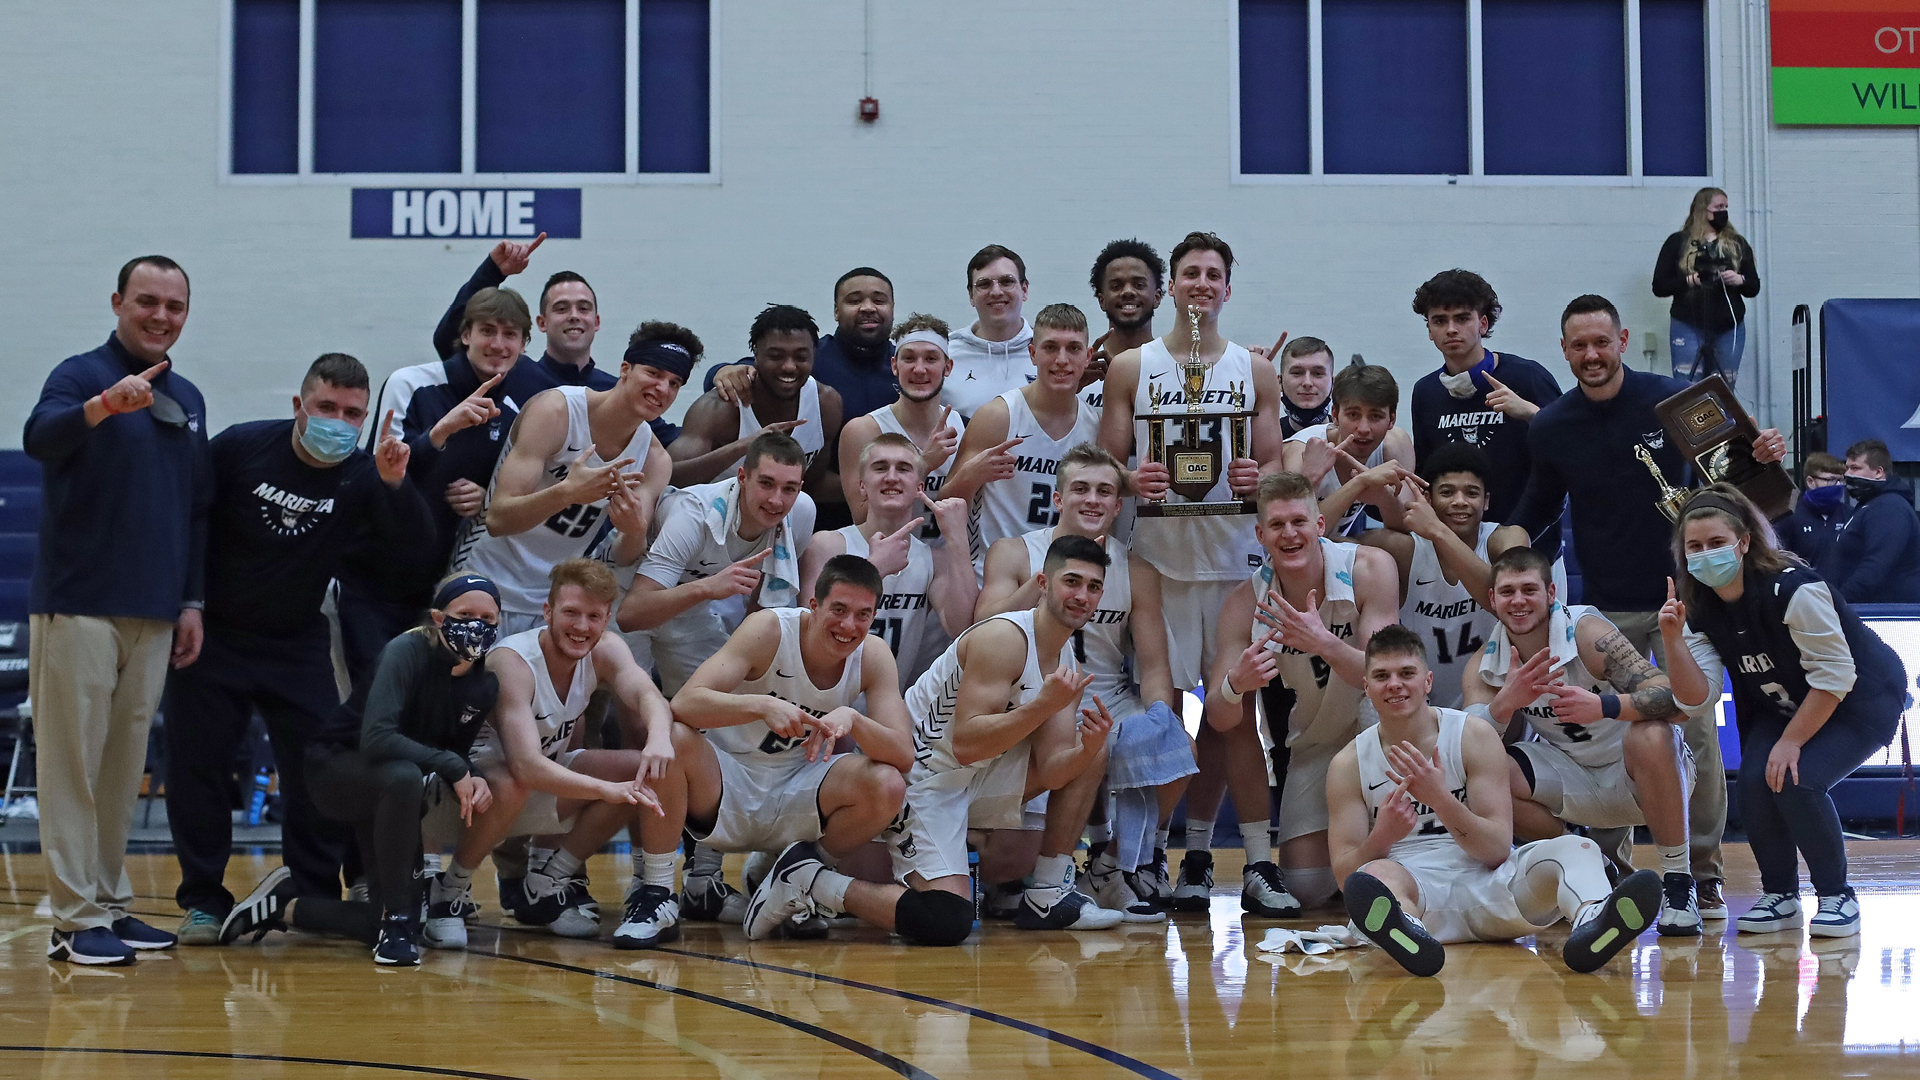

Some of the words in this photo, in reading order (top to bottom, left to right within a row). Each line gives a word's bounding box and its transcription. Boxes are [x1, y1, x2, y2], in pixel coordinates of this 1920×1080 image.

[1851, 83, 1920, 110] WIL
[392, 190, 536, 236] HOME
[1438, 411, 1504, 429] MARIETTA
[1695, 410, 1716, 425] OAC
[1187, 464, 1208, 473] OAC
[544, 503, 603, 538] 25
[1415, 598, 1478, 620] MARIET
[1432, 621, 1483, 664] 14
